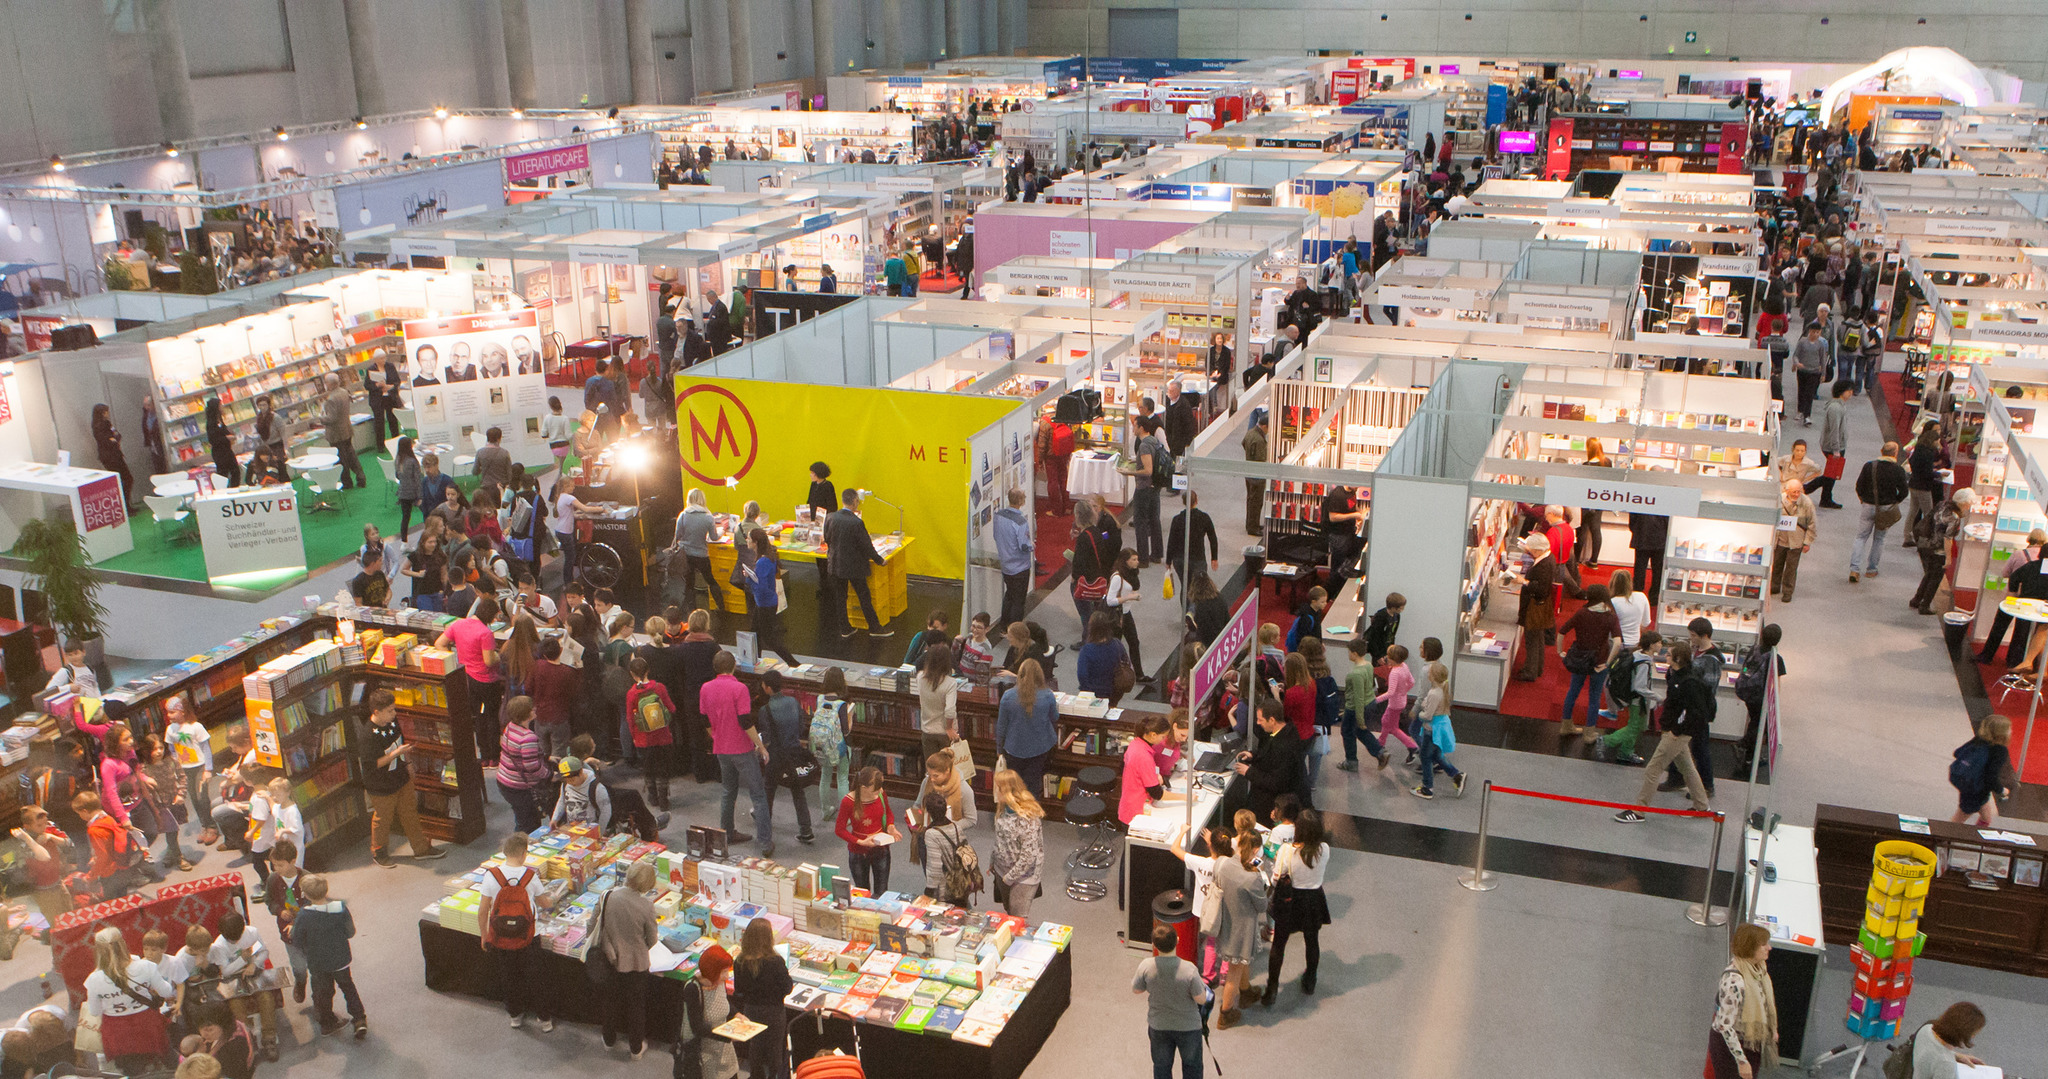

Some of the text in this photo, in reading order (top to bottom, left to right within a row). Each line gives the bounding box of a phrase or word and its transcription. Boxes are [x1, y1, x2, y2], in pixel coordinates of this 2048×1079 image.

[1052, 232, 1062, 240] Die
[1052, 240, 1081, 248] schönsten
[1052, 248, 1072, 256] Bücher
[1009, 272, 1033, 280] BERGER
[1033, 273, 1050, 281] HORN
[1053, 274, 1069, 282] WIEN
[1113, 278, 1157, 288] VERLAGSHAUS
[1172, 280, 1192, 289] ÄRZTE
[1431, 295, 1451, 303] Verlag
[1523, 301, 1593, 311] echomedia buchverlag
[1978, 328, 2032, 338] HERMAGORAS
[689, 404, 741, 462] M
[1586, 487, 1657, 506] böhlau
[83, 494, 121, 517] BUCH
[221, 499, 273, 518] sbvv
[86, 506, 124, 529] PREIS
[224, 521, 266, 532] Schweizer
[281, 524, 298, 534] und
[227, 534, 299, 549] Verleger-Verband
[1207, 618, 1245, 685] KASSA
[1884, 860, 1918, 877] Reclam
